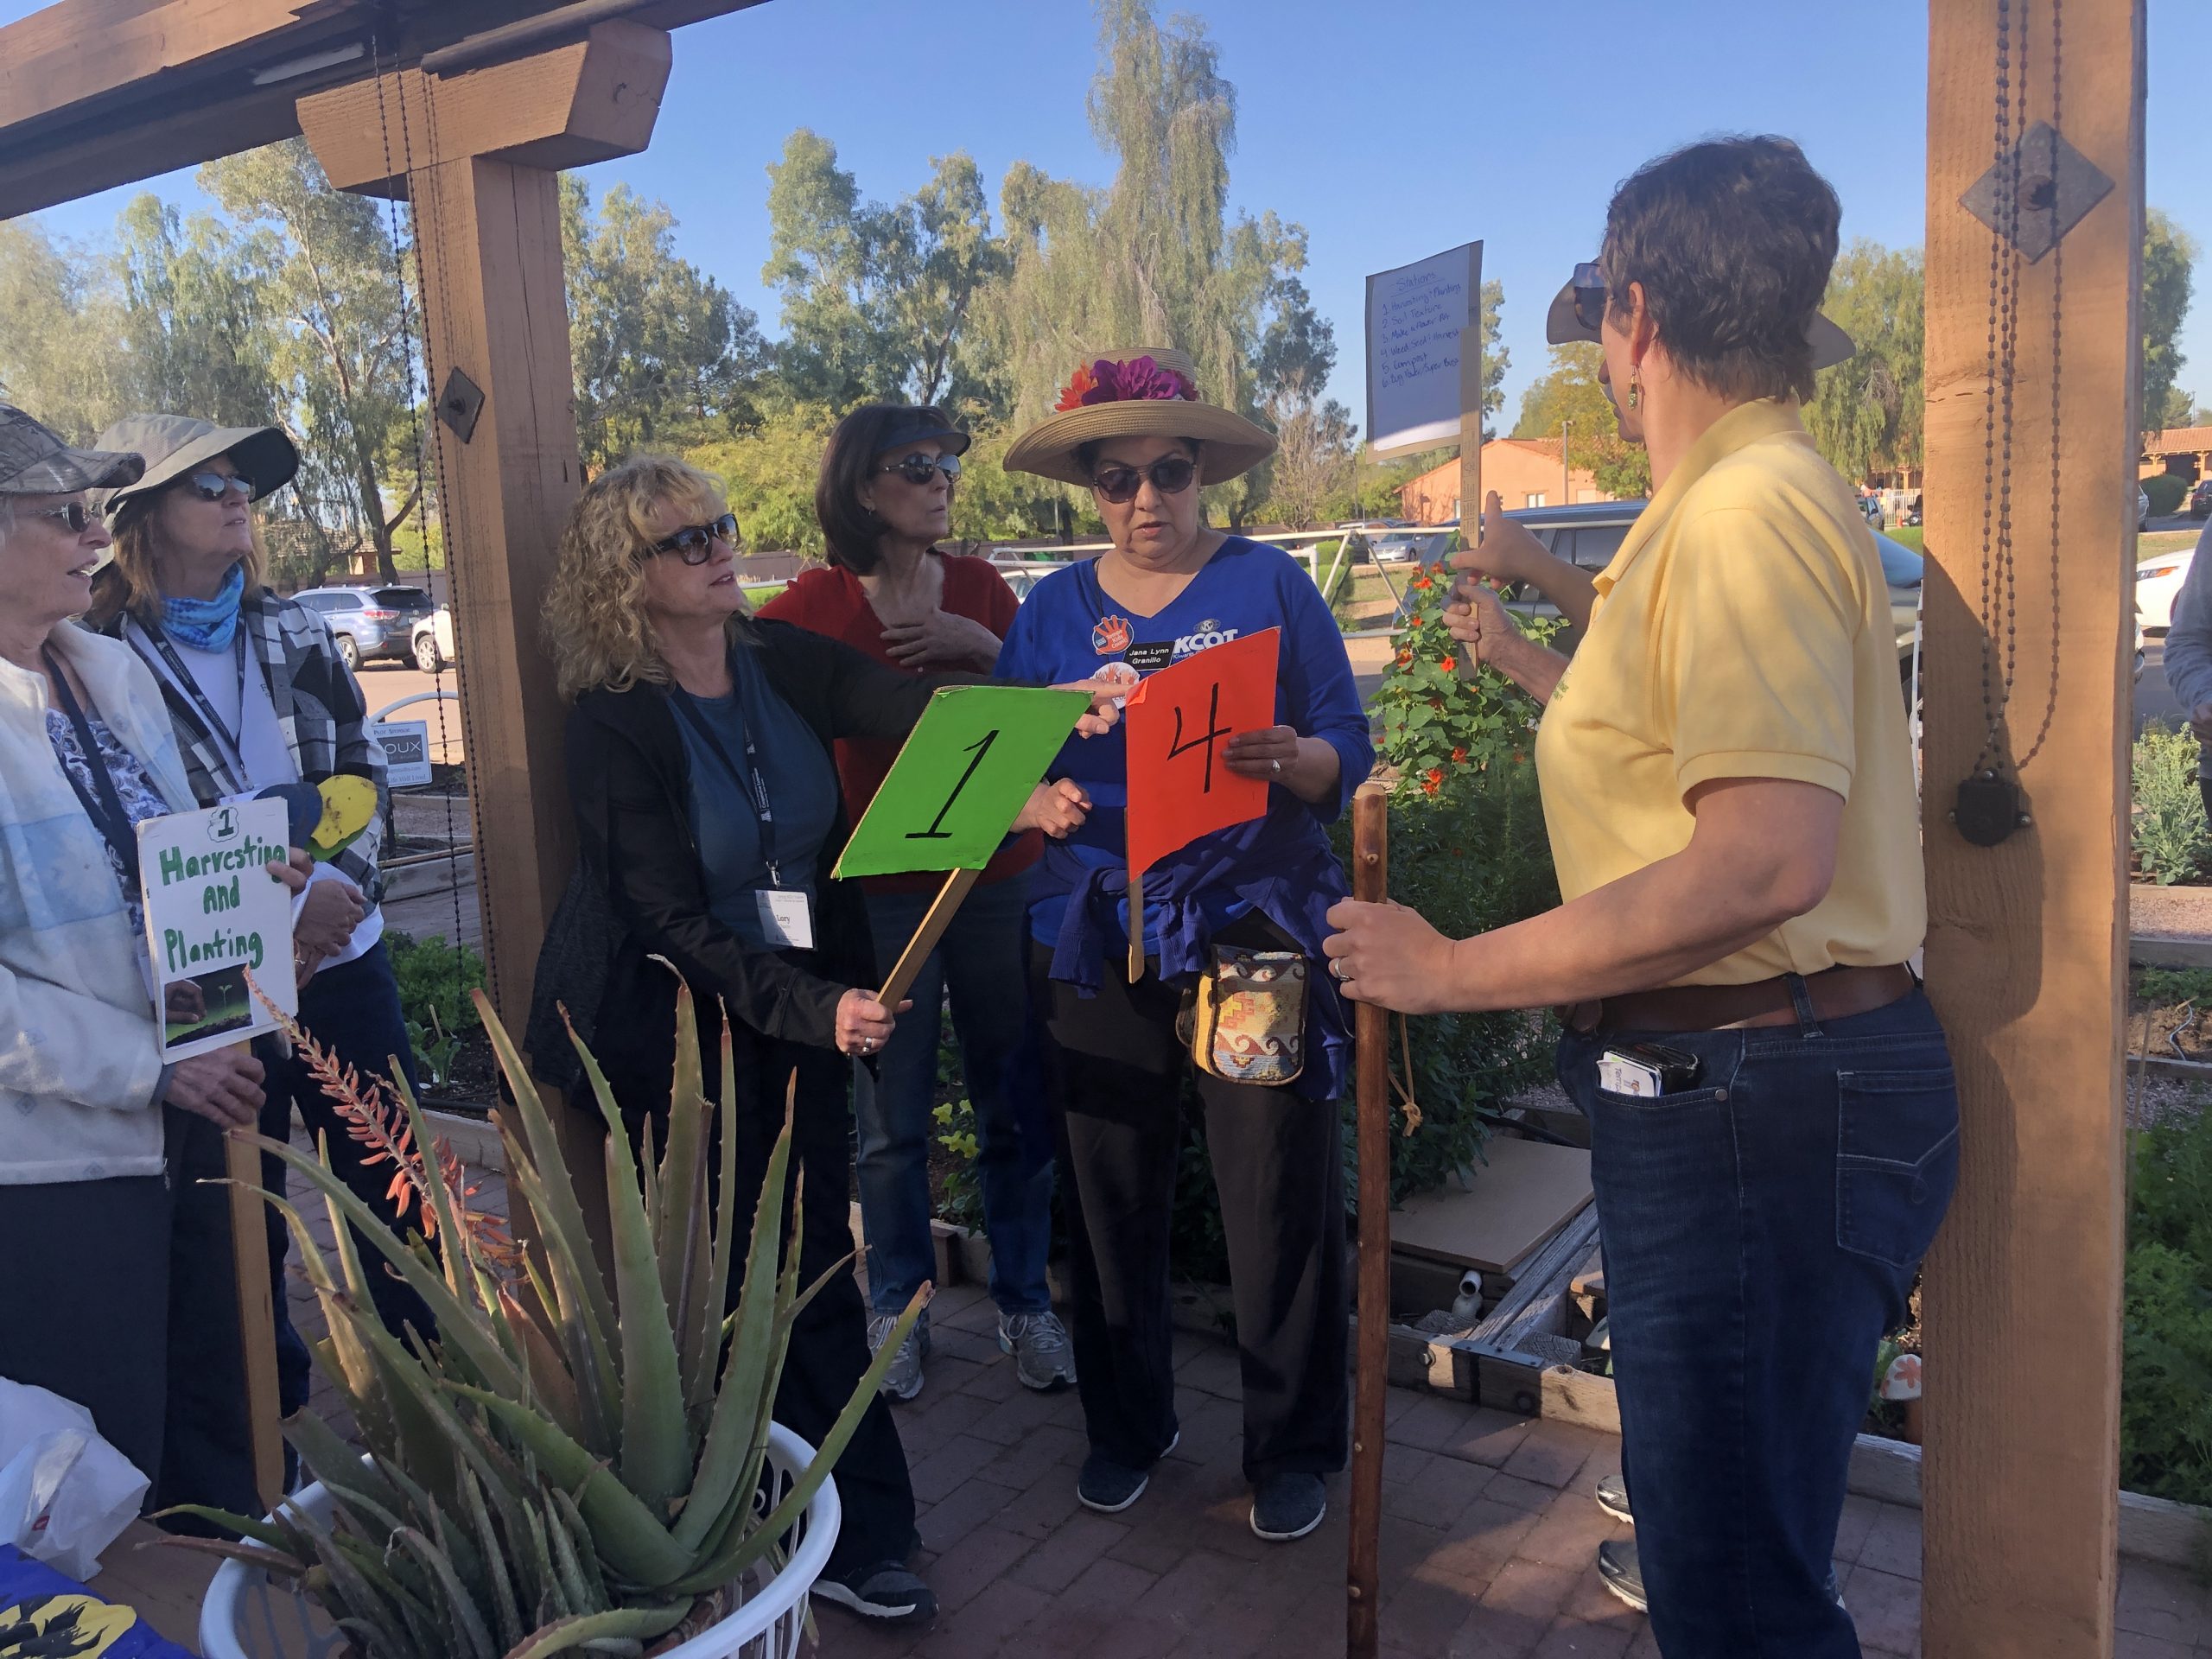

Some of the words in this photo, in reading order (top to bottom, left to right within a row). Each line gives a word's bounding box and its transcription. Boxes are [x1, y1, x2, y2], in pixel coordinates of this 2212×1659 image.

[1396, 271, 1437, 290] Stations
[1391, 310, 1408, 325] Soil
[1410, 303, 1442, 318] Texture
[1391, 328, 1409, 339] Make
[1174, 628, 1238, 653] KCOT
[385, 741, 422, 754] OUX
[1166, 682, 1232, 794] 4
[904, 729, 1000, 839] 1
[218, 809, 234, 837] 1
[159, 835, 287, 886] Harvesting
[164, 927, 264, 973] Planting
